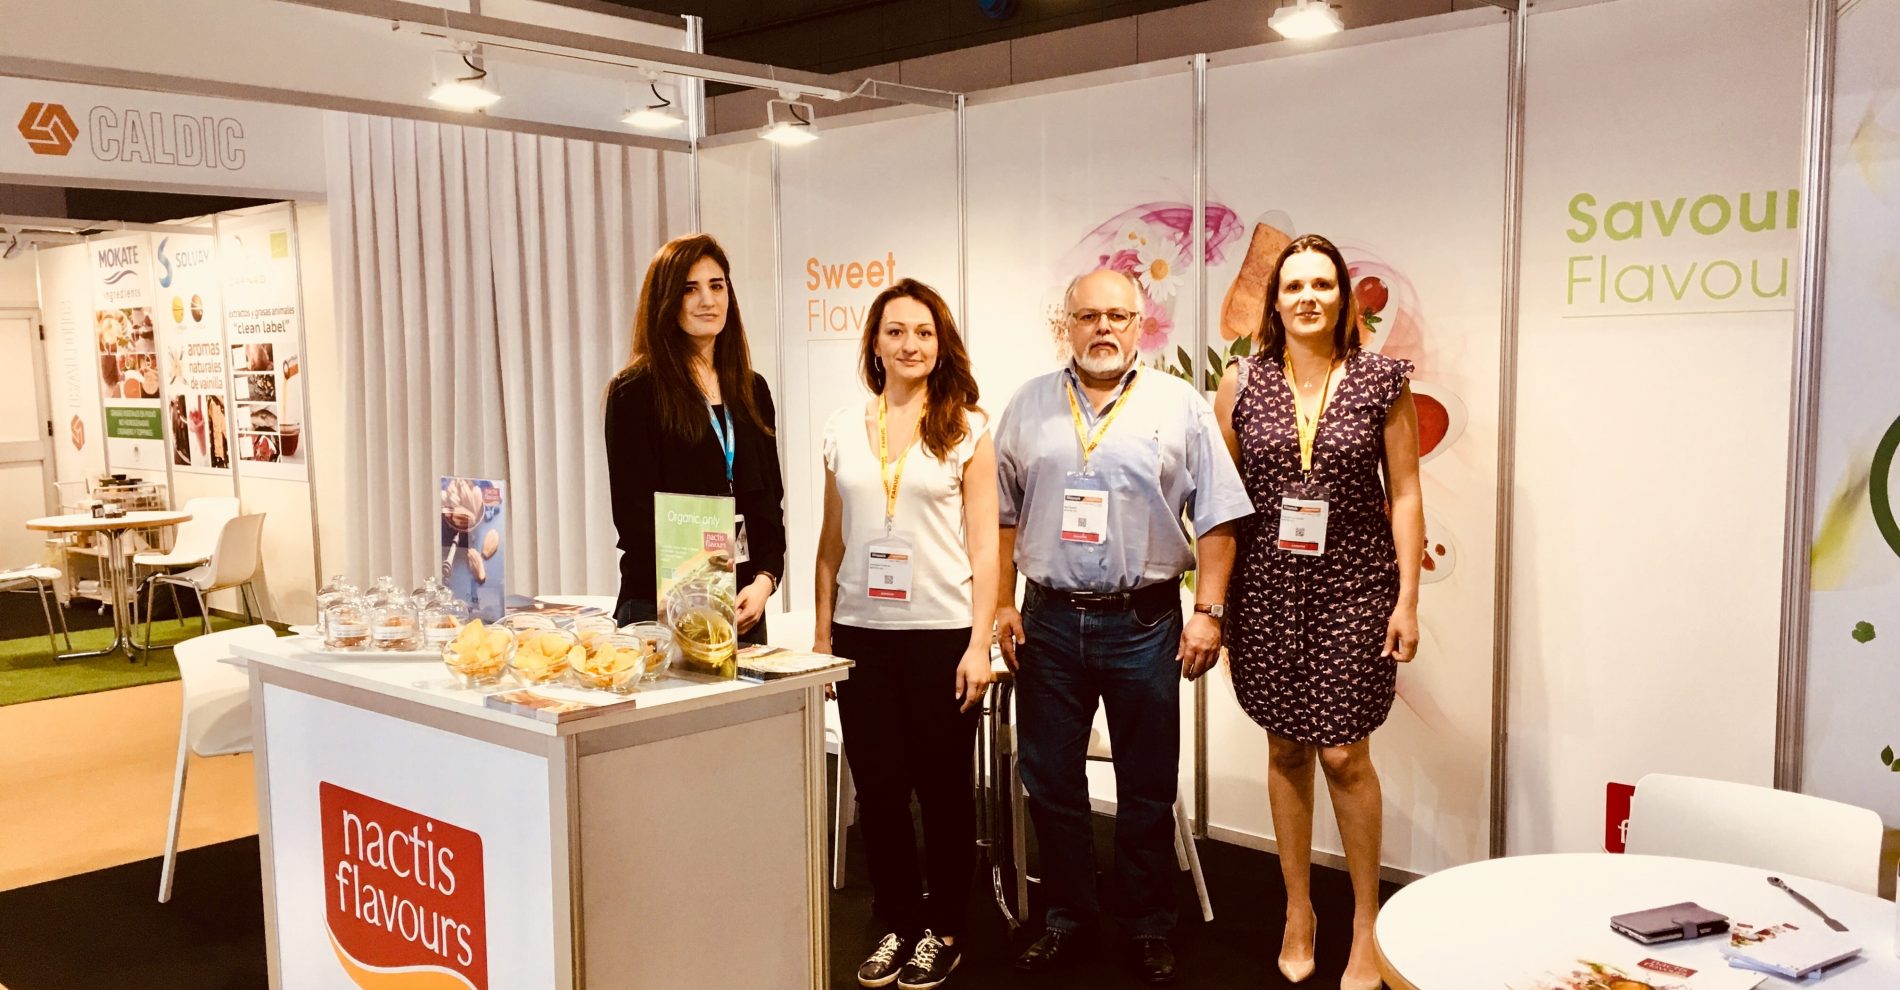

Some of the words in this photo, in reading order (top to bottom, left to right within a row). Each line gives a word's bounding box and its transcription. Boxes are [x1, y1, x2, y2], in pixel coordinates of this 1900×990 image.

[89, 105, 246, 170] CALDIC
[98, 245, 140, 269] MOKATE
[175, 249, 210, 268] SOLVAY
[806, 251, 896, 291] Sweet
[1567, 254, 1788, 305] Flavou
[104, 287, 142, 303] ingredients
[808, 299, 866, 332] Flav
[187, 342, 220, 356] aromas
[189, 360, 222, 373] naturales
[190, 376, 199, 389] de
[890, 474, 900, 499] FANUC
[668, 511, 700, 525] Organic
[703, 514, 720, 528] only
[342, 809, 456, 896] nactis
[335, 860, 473, 967] flavours
